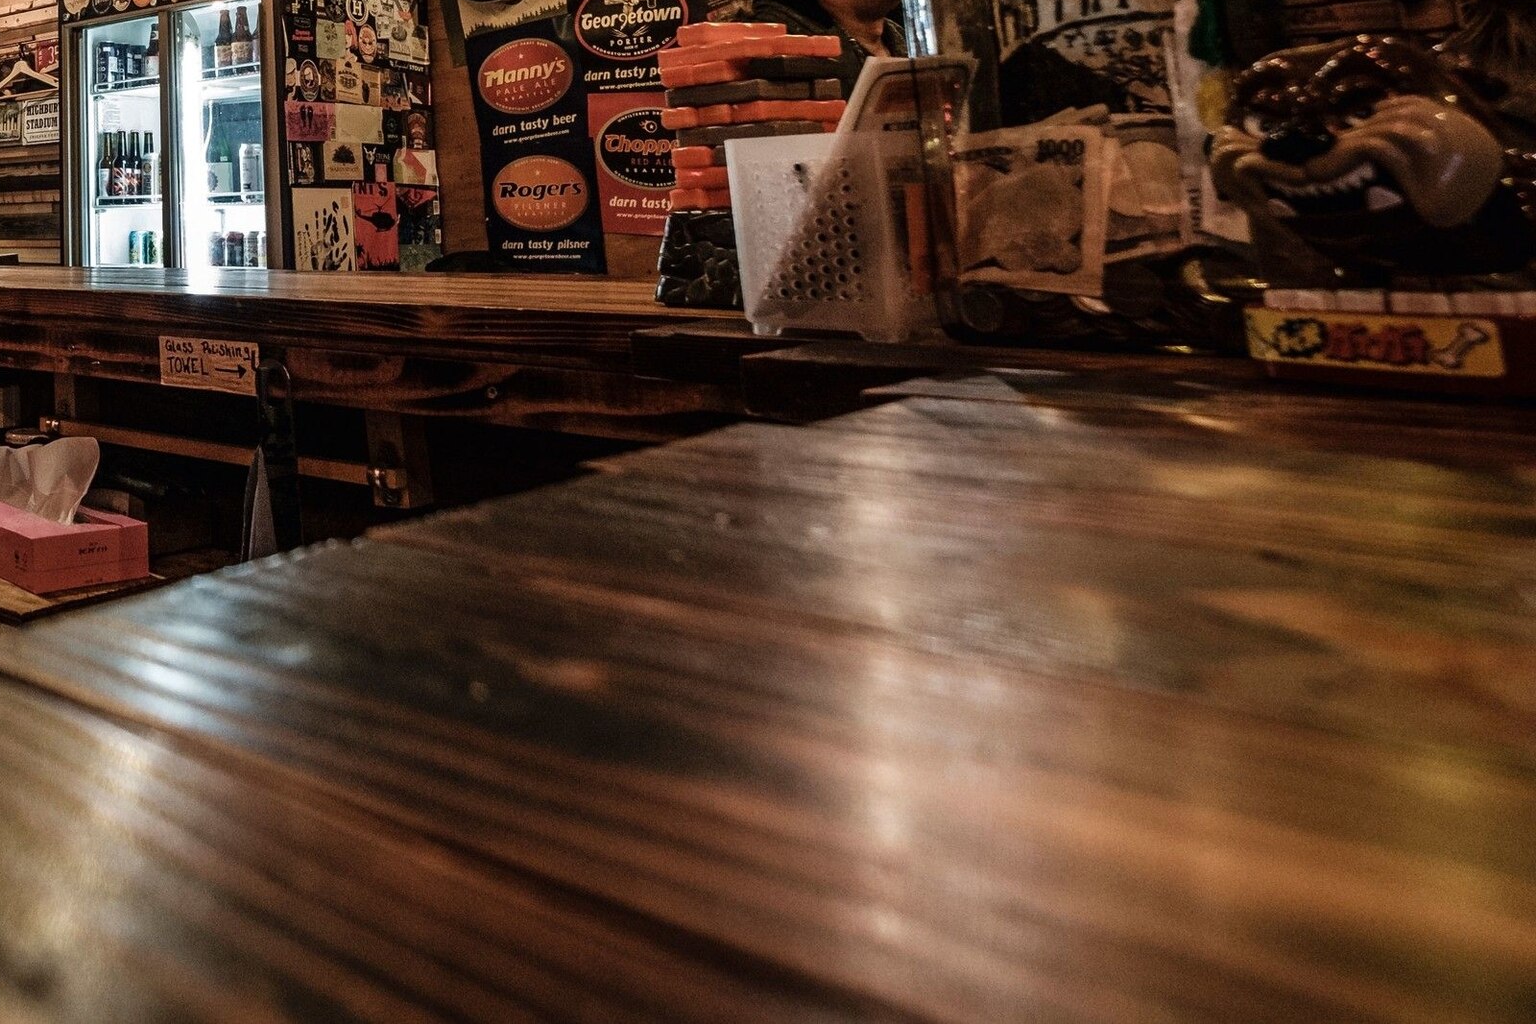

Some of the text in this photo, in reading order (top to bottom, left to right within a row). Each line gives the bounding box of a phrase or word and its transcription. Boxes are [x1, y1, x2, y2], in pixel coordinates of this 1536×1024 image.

[351, 0, 363, 17] H
[580, 4, 682, 32] Georgetown
[609, 35, 653, 47] PORTER
[483, 57, 566, 88] Manny's
[583, 66, 611, 82] darn
[614, 64, 647, 82] tasty
[495, 78, 557, 97] PALE ALE
[26, 117, 59, 130] STADIUM
[492, 112, 578, 137] darn tasty beer
[1035, 138, 1085, 164] 1000
[630, 157, 650, 167] RED
[498, 179, 585, 201] Roger's
[513, 201, 568, 211] PILSNER
[609, 196, 674, 212] darn tasty
[501, 238, 591, 251] darn tasty pilsner
[164, 339, 194, 354] Glass
[166, 356, 210, 376] TOWEL
